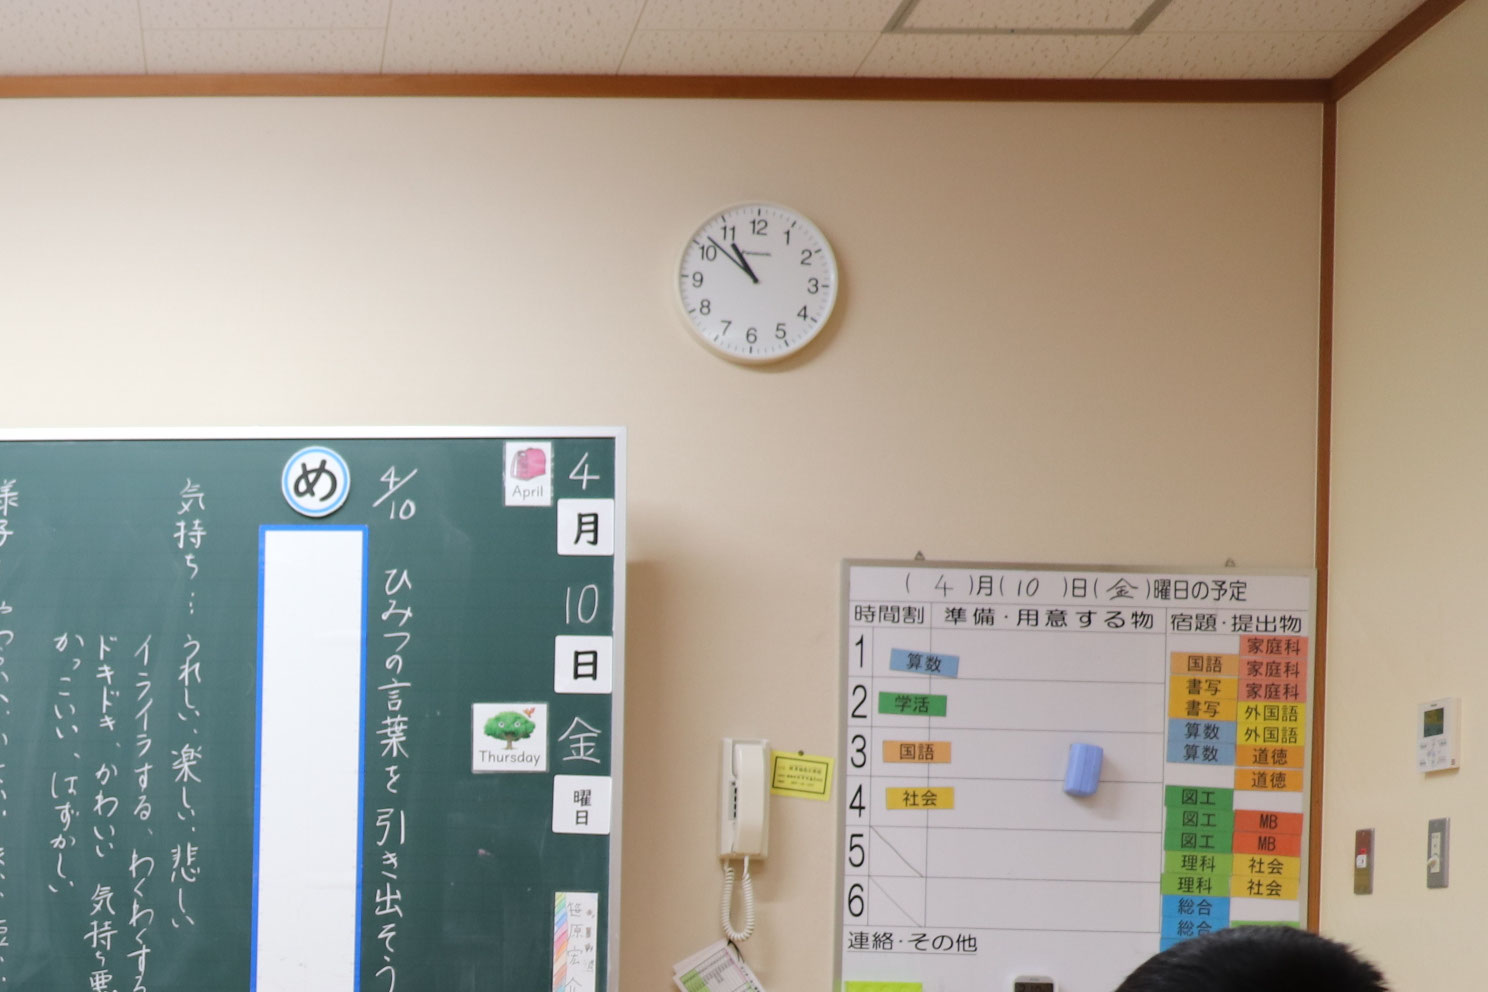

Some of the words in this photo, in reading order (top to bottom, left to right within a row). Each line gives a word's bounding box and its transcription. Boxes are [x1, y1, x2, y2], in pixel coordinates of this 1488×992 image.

[721, 225, 736, 241] 11
[750, 219, 768, 235] 12
[784, 230, 790, 245] 1
[699, 245, 717, 262] 10
[800, 249, 812, 266] 2
[692, 272, 704, 288] 9
[807, 278, 819, 294] 3
[699, 299, 711, 316] 8
[797, 305, 808, 321] 4
[721, 320, 733, 336] 7
[746, 327, 757, 344] 6
[775, 323, 787, 339] 5
[569, 452, 600, 490] 4
[293, 459, 338, 502] め
[372, 466, 418, 520] 4/10
[512, 484, 544, 499] April
[573, 512, 599, 546] 月
[566, 584, 599, 624] 10
[854, 604, 924, 625] 時間割
[855, 634, 864, 668] 1
[1247, 637, 1301, 656] 家庭科
[573, 650, 598, 680] 日
[906, 652, 943, 673] 算数
[1188, 655, 1222, 673] 国語
[1247, 660, 1300, 679] 家庭科
[1186, 678, 1222, 696] 書写
[1246, 683, 1300, 701] 家庭科
[851, 684, 867, 718] 2
[894, 695, 930, 714] 学活
[1185, 700, 1221, 718] 書写
[1245, 704, 1299, 722] 外国語
[558, 716, 602, 763] 金
[1185, 722, 1220, 740] 算数
[1244, 726, 1298, 744] 外国語
[479, 750, 541, 767] Thursday
[850, 734, 867, 768] 3
[899, 743, 935, 761] 国語
[1184, 743, 1219, 762] 算数
[1252, 747, 1288, 766] 道徳
[1251, 771, 1287, 789] 道徳
[849, 784, 866, 818] 4
[902, 790, 938, 807] 社会
[1182, 788, 1216, 806] 図工
[573, 788, 592, 826] 曜日
[1182, 810, 1217, 827] 図工
[1259, 813, 1278, 830] MB
[1181, 832, 1215, 849] 図工
[1257, 835, 1276, 852] MB
[848, 833, 865, 867] 5
[1181, 854, 1216, 873] 理科
[1249, 857, 1284, 875] 社会
[1177, 876, 1212, 894] 理科
[1246, 878, 1282, 897] 社会
[848, 883, 864, 917] 6
[1178, 897, 1212, 916] 総合
